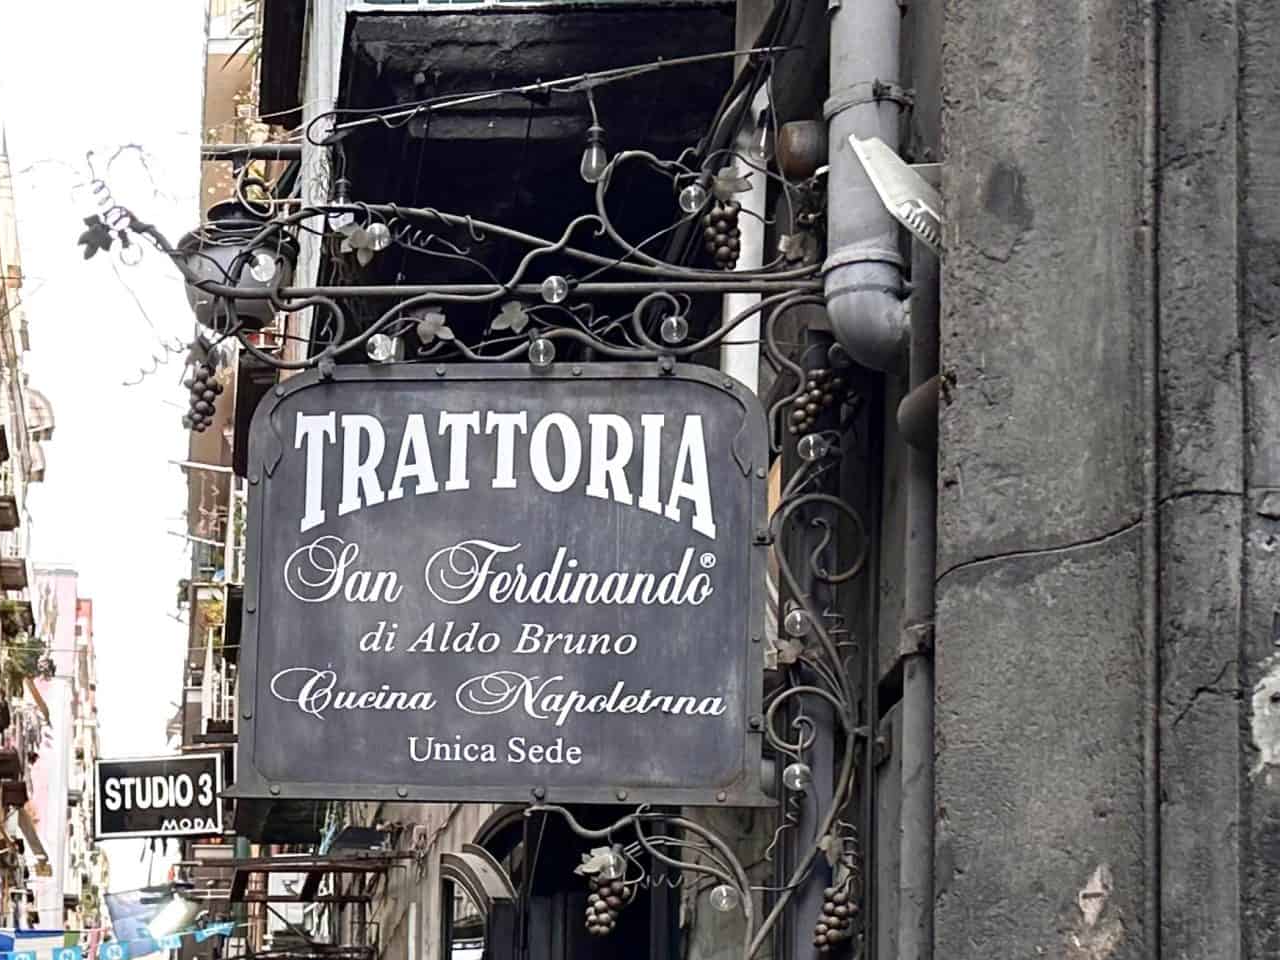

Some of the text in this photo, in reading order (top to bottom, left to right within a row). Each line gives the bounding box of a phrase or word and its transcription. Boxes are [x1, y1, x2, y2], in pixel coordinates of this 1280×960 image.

[294, 409, 717, 541] TRATTORIA
[284, 535, 713, 606] San Ferdinando
[359, 621, 638, 655] di Aldo Bruno
[270, 666, 436, 721] Cucina
[408, 736, 583, 764] Unica Sede
[104, 772, 213, 811] STUDIO 3
[161, 817, 216, 832] MODA
